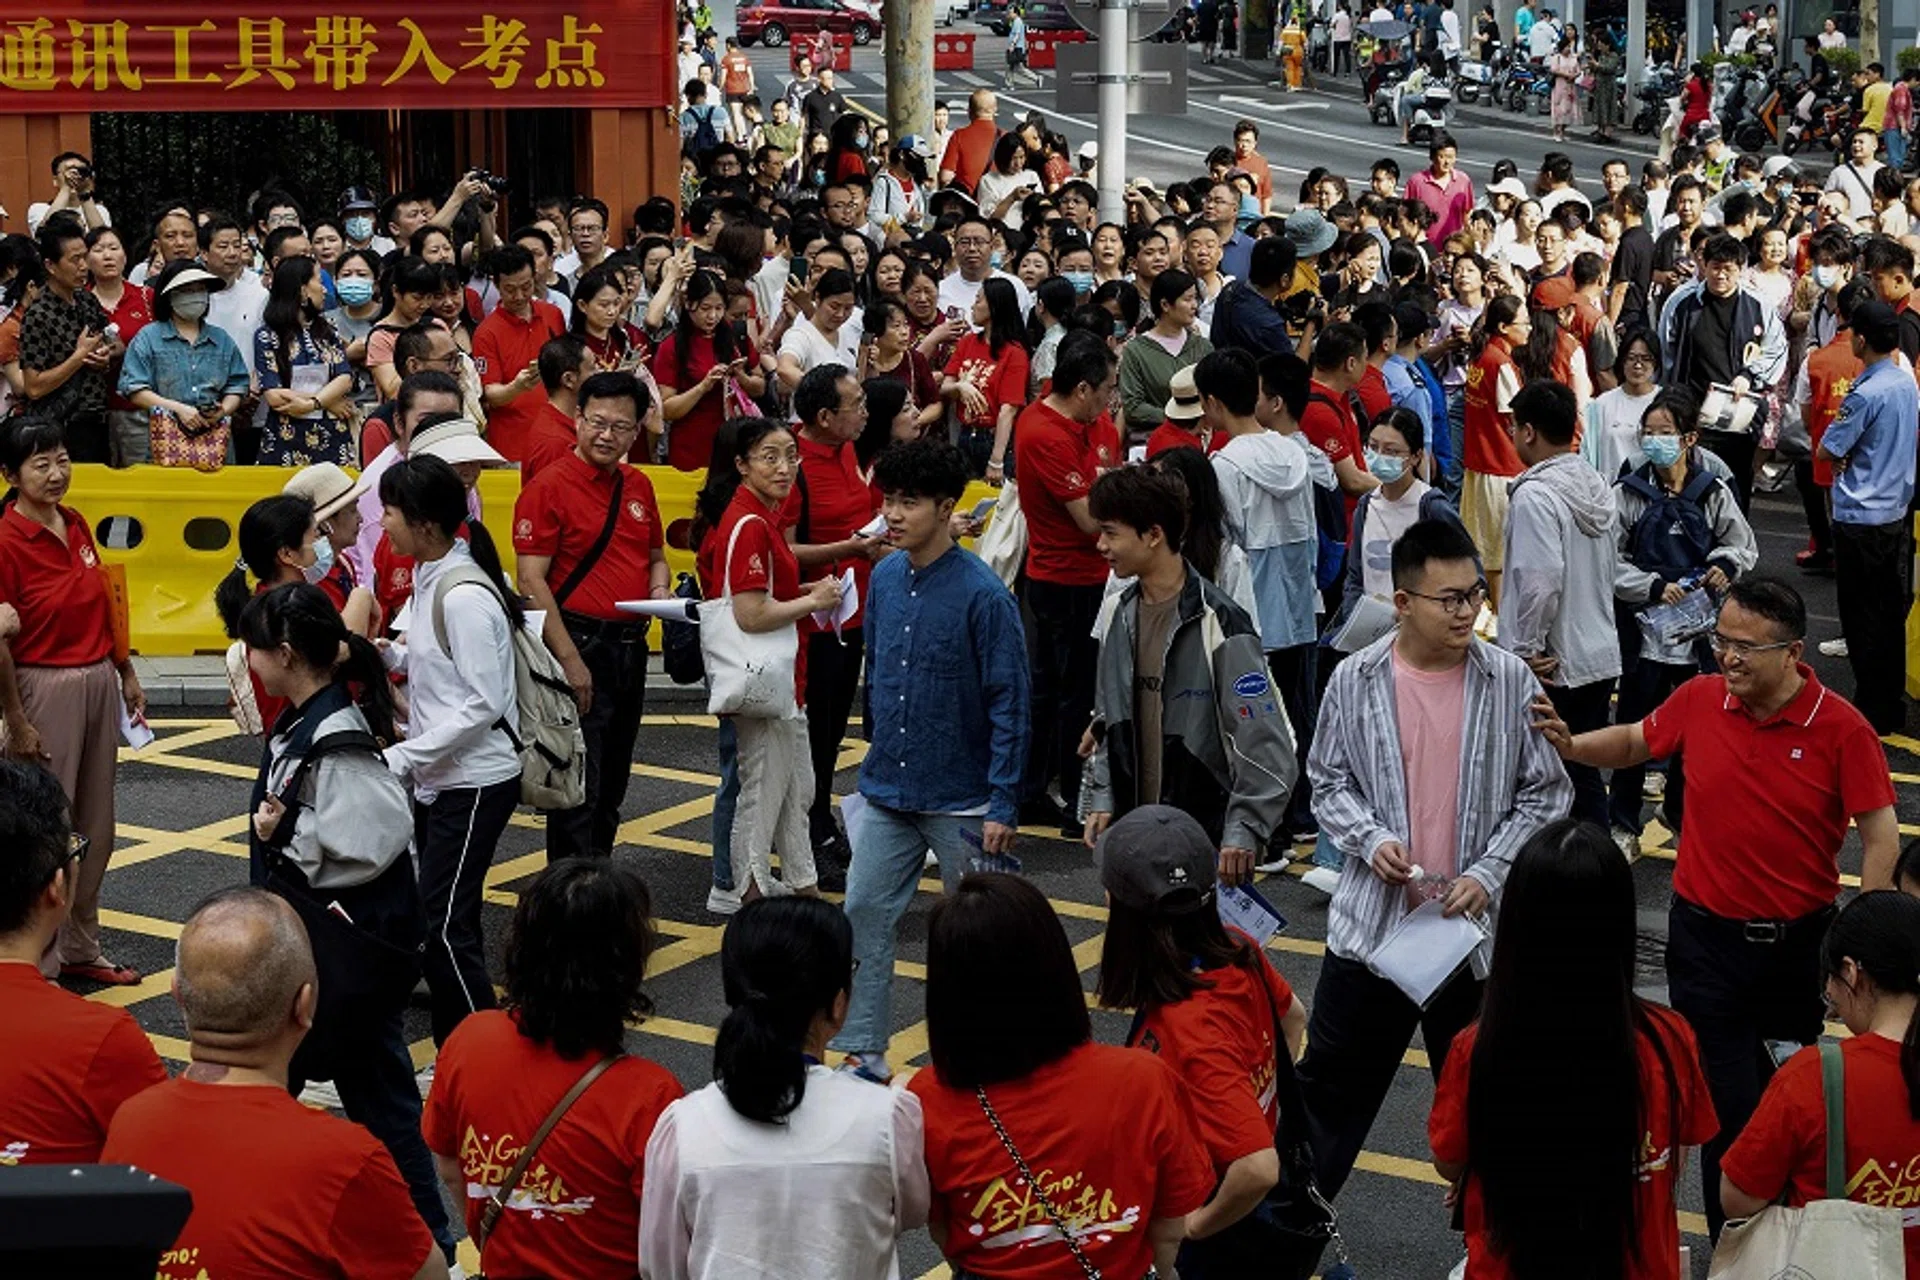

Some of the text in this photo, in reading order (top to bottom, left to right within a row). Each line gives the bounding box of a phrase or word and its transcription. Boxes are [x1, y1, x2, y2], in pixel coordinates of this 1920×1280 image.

[0, 15, 605, 91] 通讯工具带入考点
